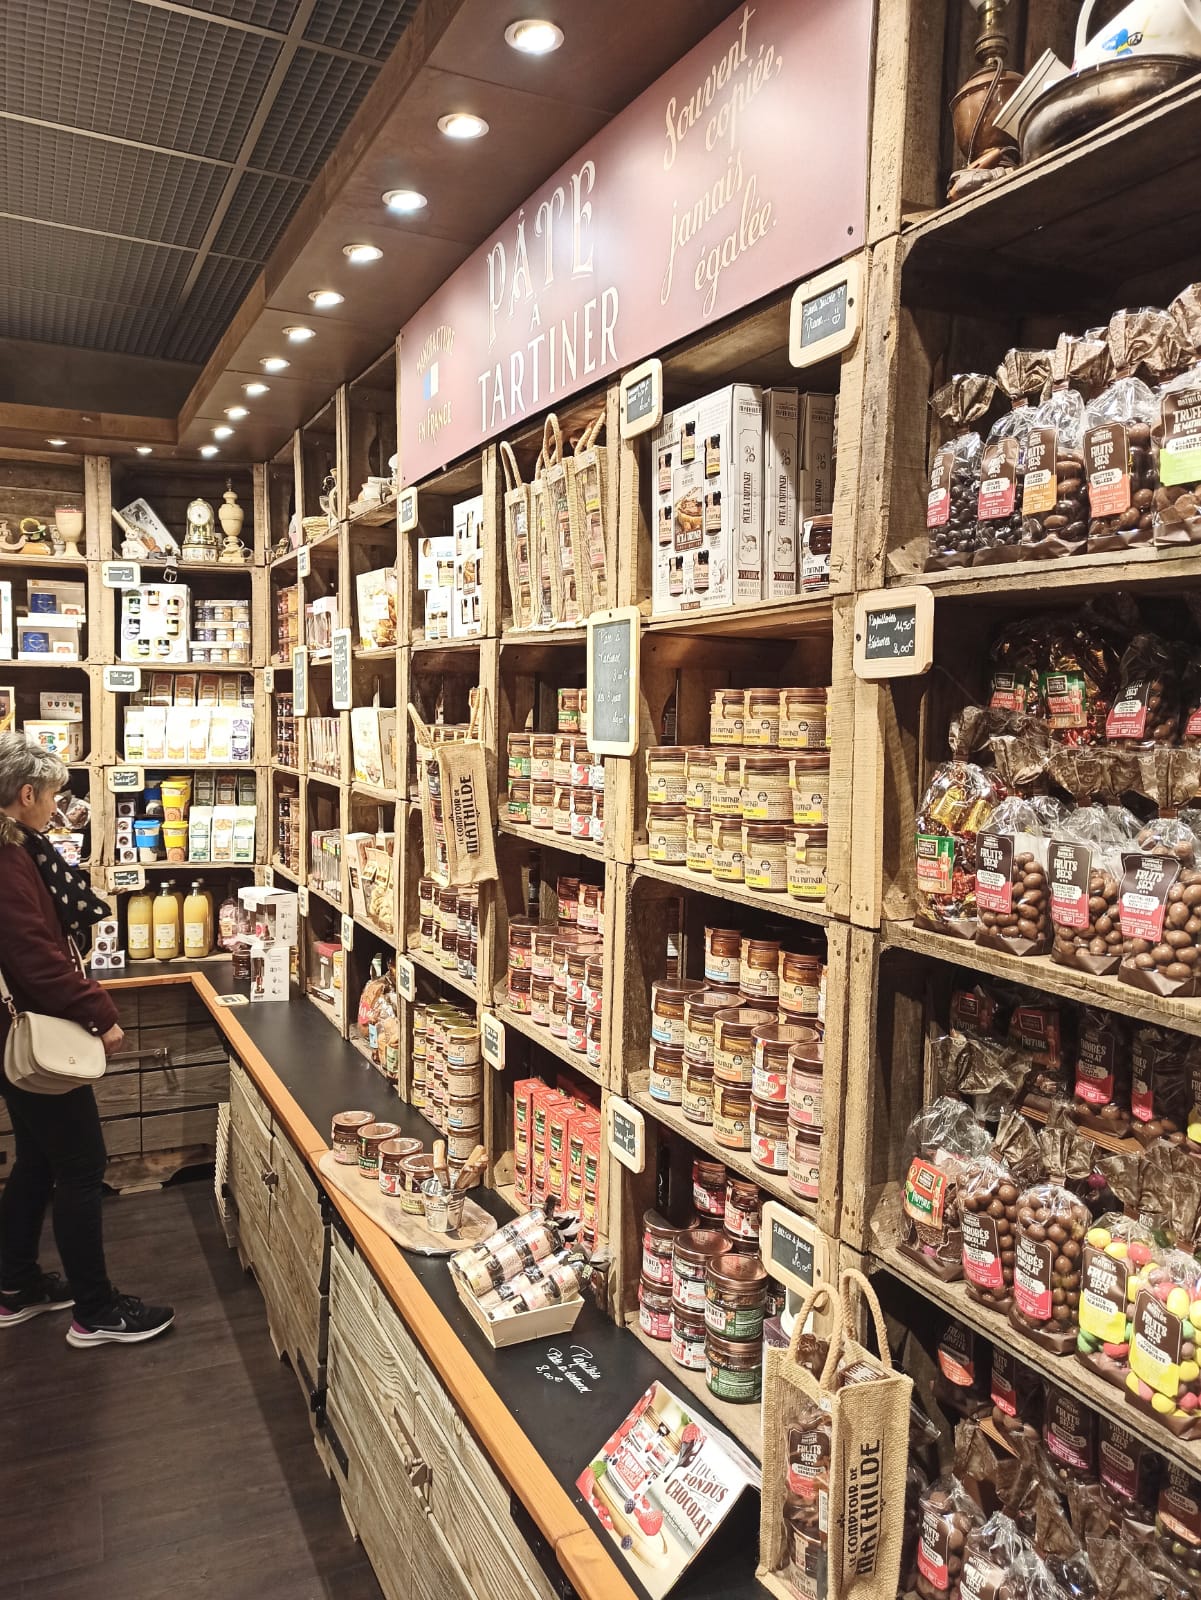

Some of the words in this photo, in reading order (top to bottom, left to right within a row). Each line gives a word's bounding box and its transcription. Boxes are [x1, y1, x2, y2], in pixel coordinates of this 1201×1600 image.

[663, 6, 756, 171] Souvent
[705, 44, 783, 151] copiée,
[660, 151, 743, 305] jamais
[486, 160, 596, 352] PÂTE
[694, 174, 777, 319] égalée.
[416, 324, 456, 377] MANUFACTURE
[477, 286, 619, 433] TARTINER
[418, 421, 427, 443] EN
[427, 401, 452, 445] FRANCE
[1091, 442, 1114, 458] FRUITS
[1095, 455, 1109, 467] SECS
[742, 472, 751, 500] TARTINER
[778, 475, 787, 503] TARTINER
[454, 796, 464, 836] COMPTOIR
[460, 774, 478, 854] MATHILDE
[981, 848, 1003, 860] FRUITS
[984, 857, 999, 868] SECS
[1054, 858, 1078, 871] FRUITS
[1056, 870, 1072, 880] SECS
[1135, 869, 1164, 882] FRUITS
[1136, 880, 1155, 891] SECS
[1087, 1266, 1117, 1287] FRUITS
[1090, 1278, 1109, 1294] SECS
[1142, 1311, 1168, 1337] FRUITS
[1144, 1328, 1161, 1344] SECS
[797, 1444, 821, 1455] FRUITS
[1111, 1433, 1129, 1449] SECS
[801, 1453, 817, 1462] SECS
[683, 1473, 729, 1502] FONDUS
[850, 1467, 858, 1481] DE
[665, 1478, 712, 1538] CHOCOLAT
[848, 1483, 859, 1553] COMPTOIR
[857, 1439, 880, 1575] MATHILDE
